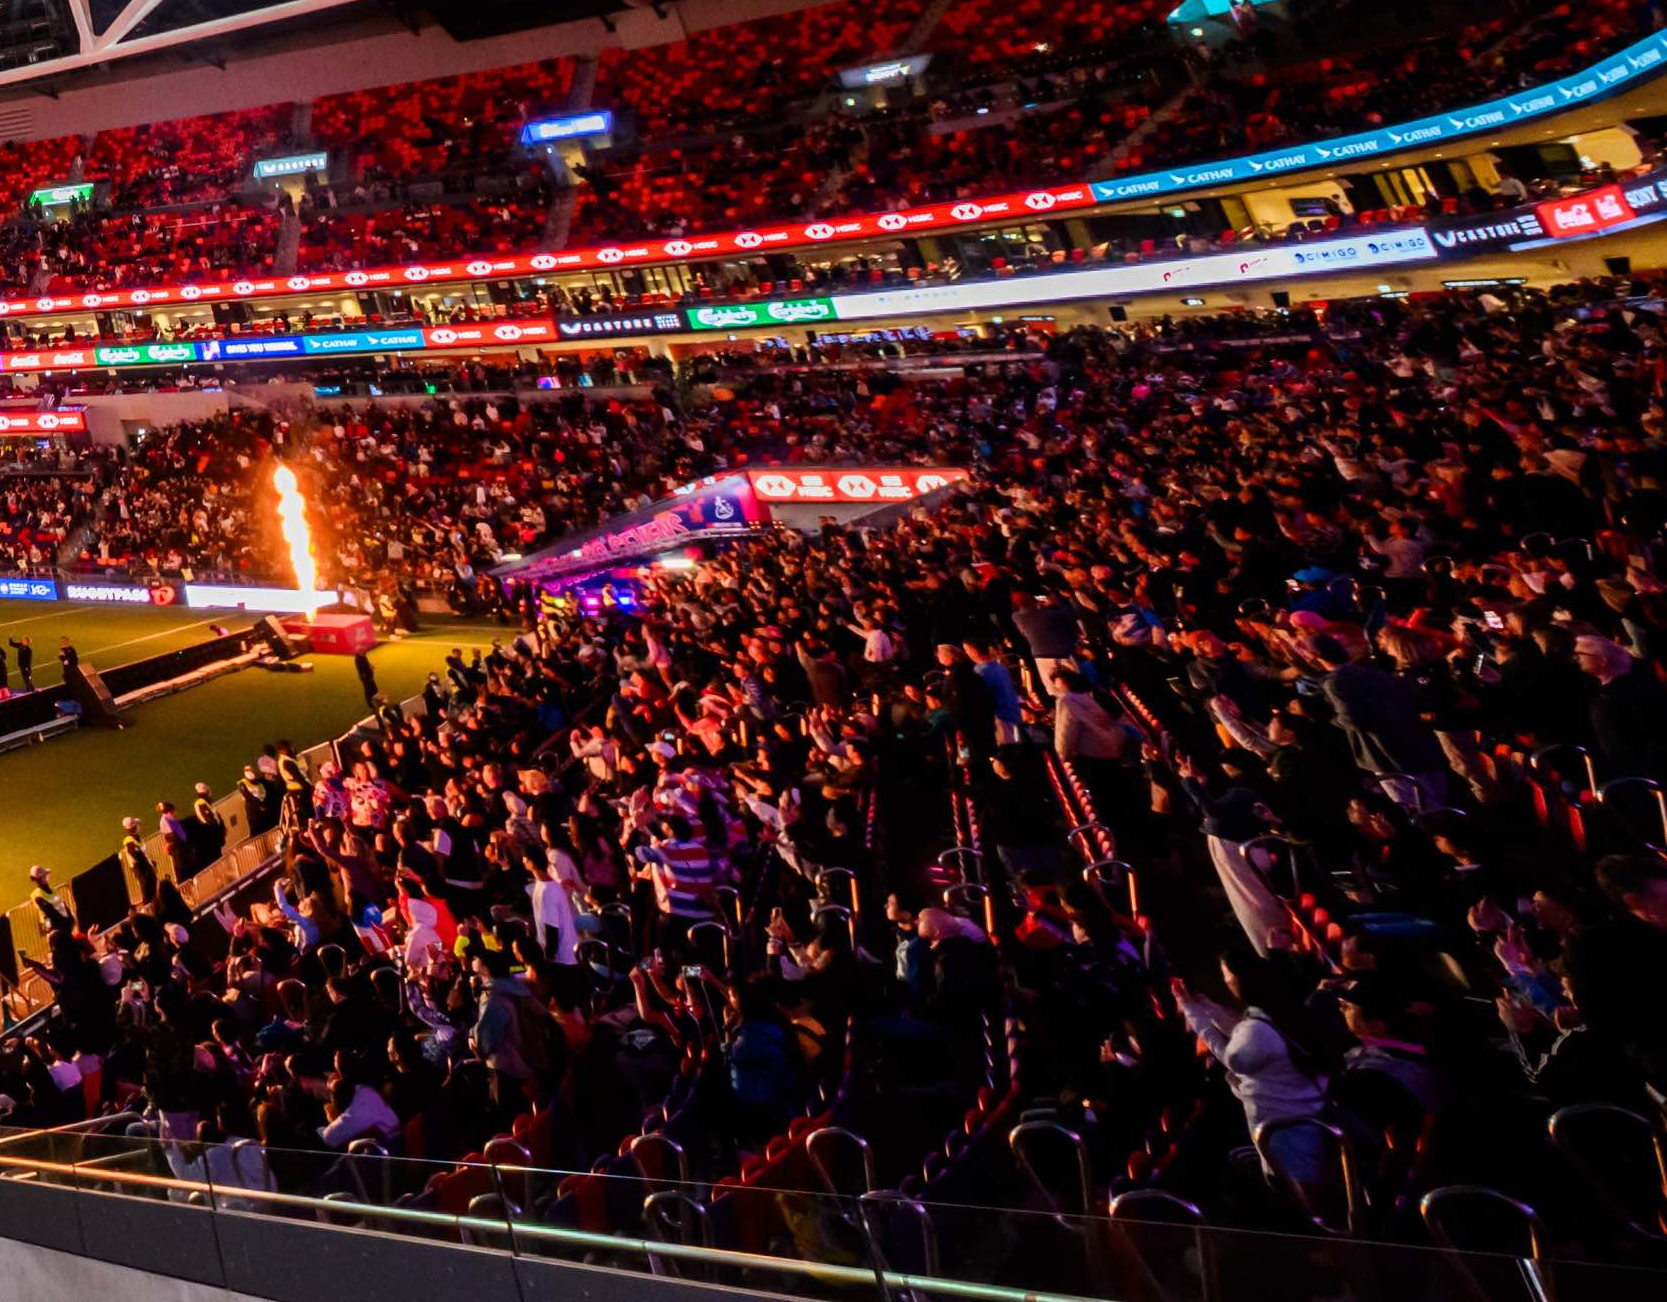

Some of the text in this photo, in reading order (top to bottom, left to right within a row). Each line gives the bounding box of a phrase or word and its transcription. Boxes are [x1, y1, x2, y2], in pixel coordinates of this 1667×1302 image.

[1467, 110, 1504, 128] CATHAY
[1403, 124, 1442, 143] CATHAY
[1332, 139, 1379, 157] CATHAY
[1264, 154, 1306, 170] CATHAY
[1187, 168, 1234, 184] CATHAY
[1117, 180, 1159, 195] CATHAY
[1055, 191, 1083, 202] HSBC
[983, 202, 1009, 212] HSBC
[907, 212, 934, 223] HSBC
[1306, 247, 1357, 261] CIMIGO
[697, 306, 757, 327] Carlsberg
[768, 300, 829, 321] Carlsberg
[322, 339, 358, 348] CATHAY
[380, 336, 417, 345] CATHAY
